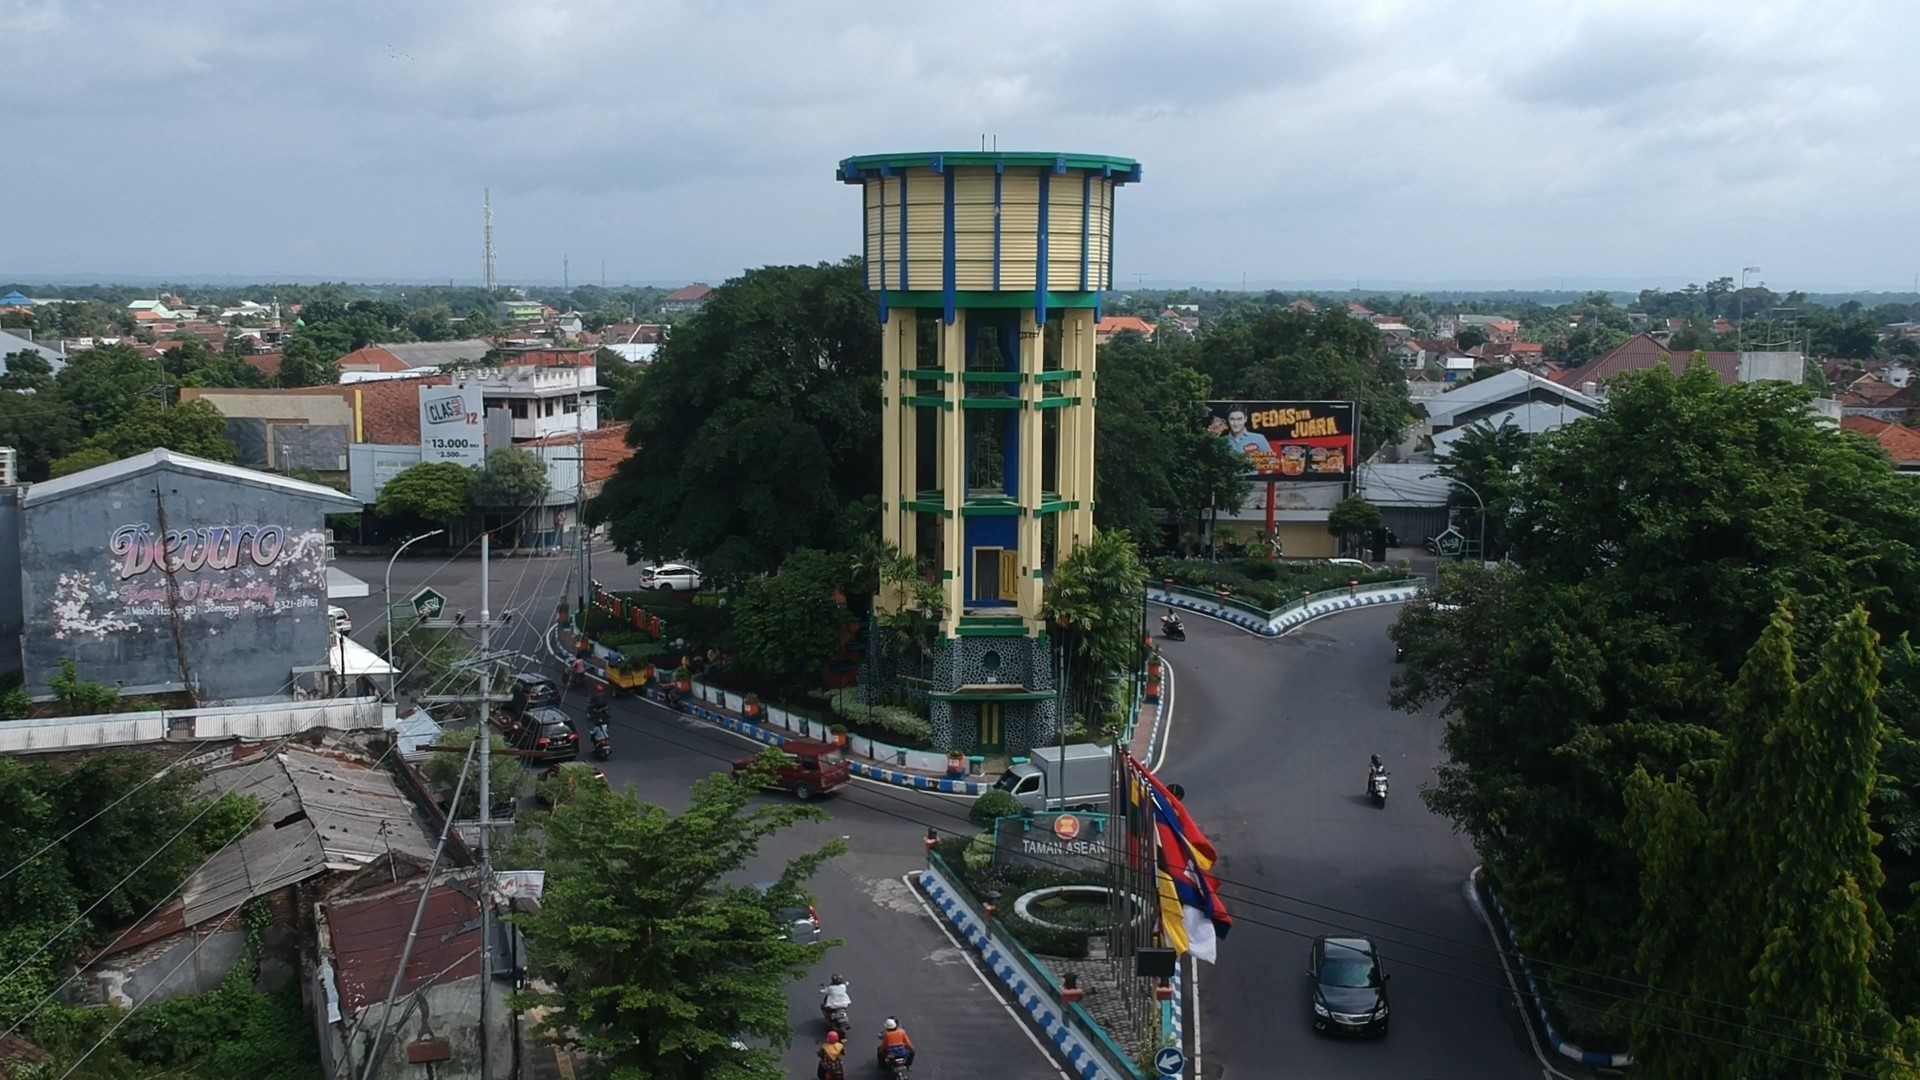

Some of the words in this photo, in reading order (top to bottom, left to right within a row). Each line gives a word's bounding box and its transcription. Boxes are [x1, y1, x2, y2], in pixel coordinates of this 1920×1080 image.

[430, 401, 454, 420] CLAS
[466, 412, 478, 424] 12
[1251, 408, 1295, 429] PEDAS
[1290, 416, 1340, 438] JUARA
[432, 439, 468, 448] 13.000
[1022, 840, 1062, 854] TAMAN
[1065, 840, 1106, 855] ASEAN
